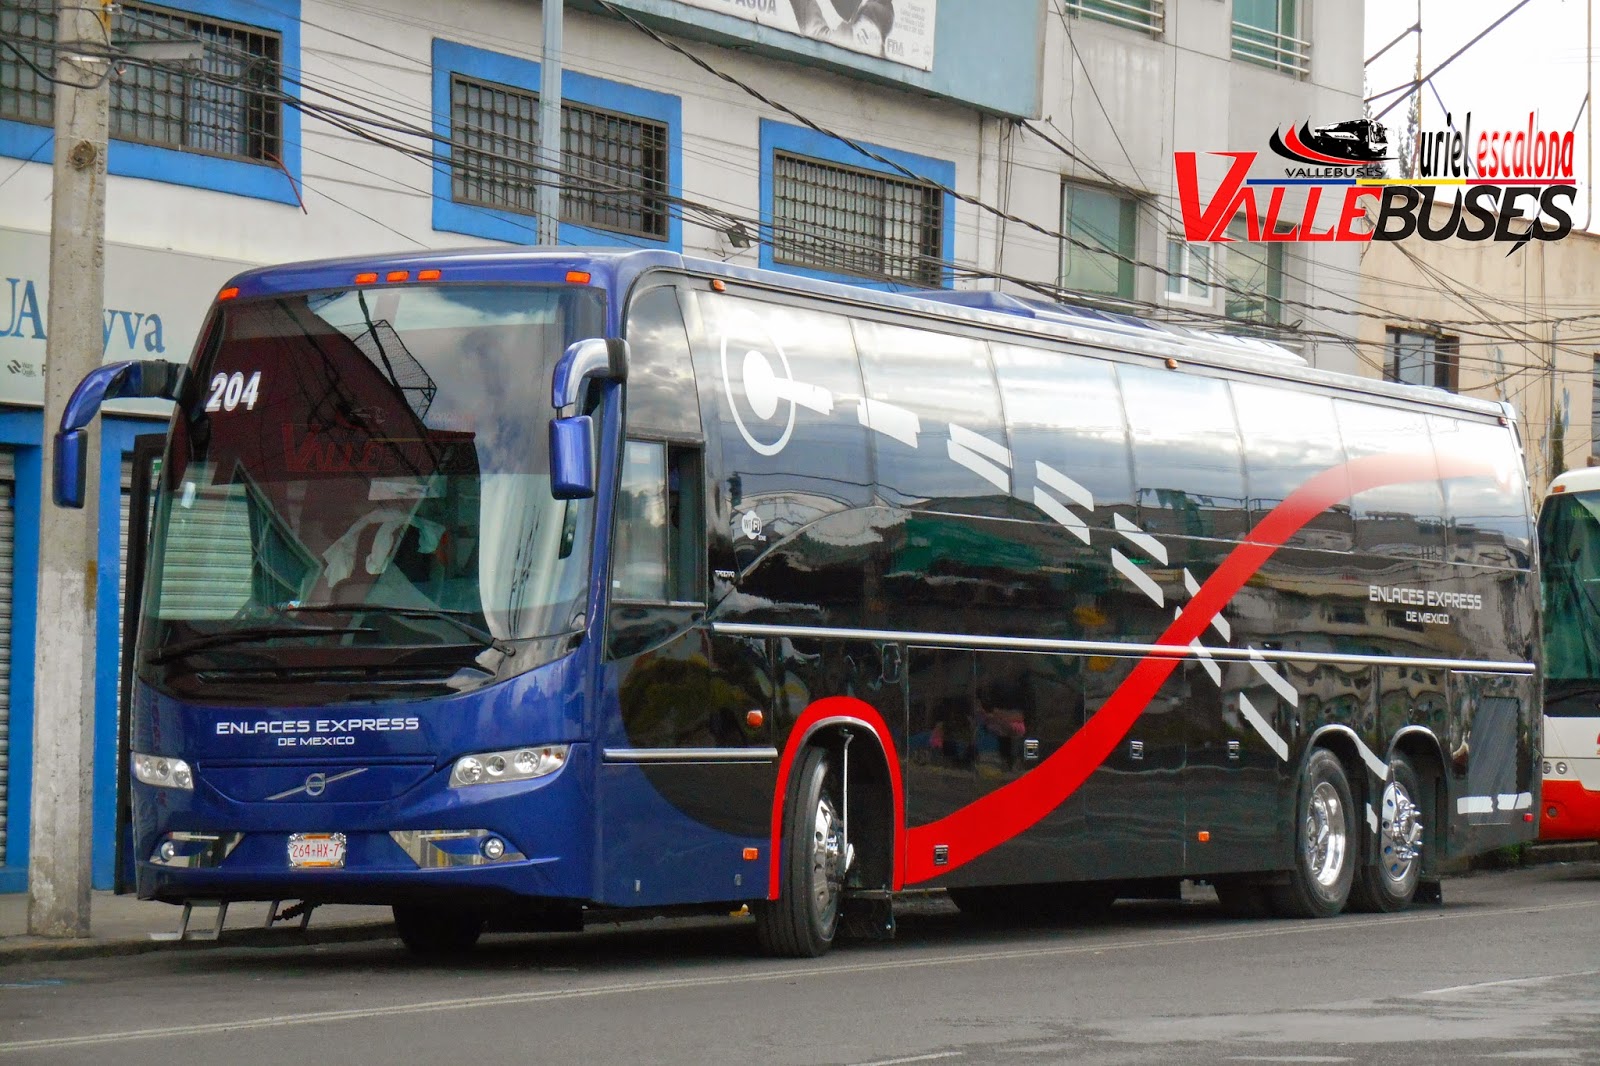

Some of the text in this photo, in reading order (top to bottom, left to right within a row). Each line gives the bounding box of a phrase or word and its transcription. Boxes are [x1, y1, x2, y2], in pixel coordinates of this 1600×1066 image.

[735, 0, 777, 16] UA
[205, 371, 261, 412] 204
[1369, 585, 1482, 610] ENLACES EXPRESS
[1405, 611, 1450, 625] DE MEXICO
[216, 717, 419, 735] ENLACES EXPRESS
[277, 736, 355, 747] DE MEXICO
